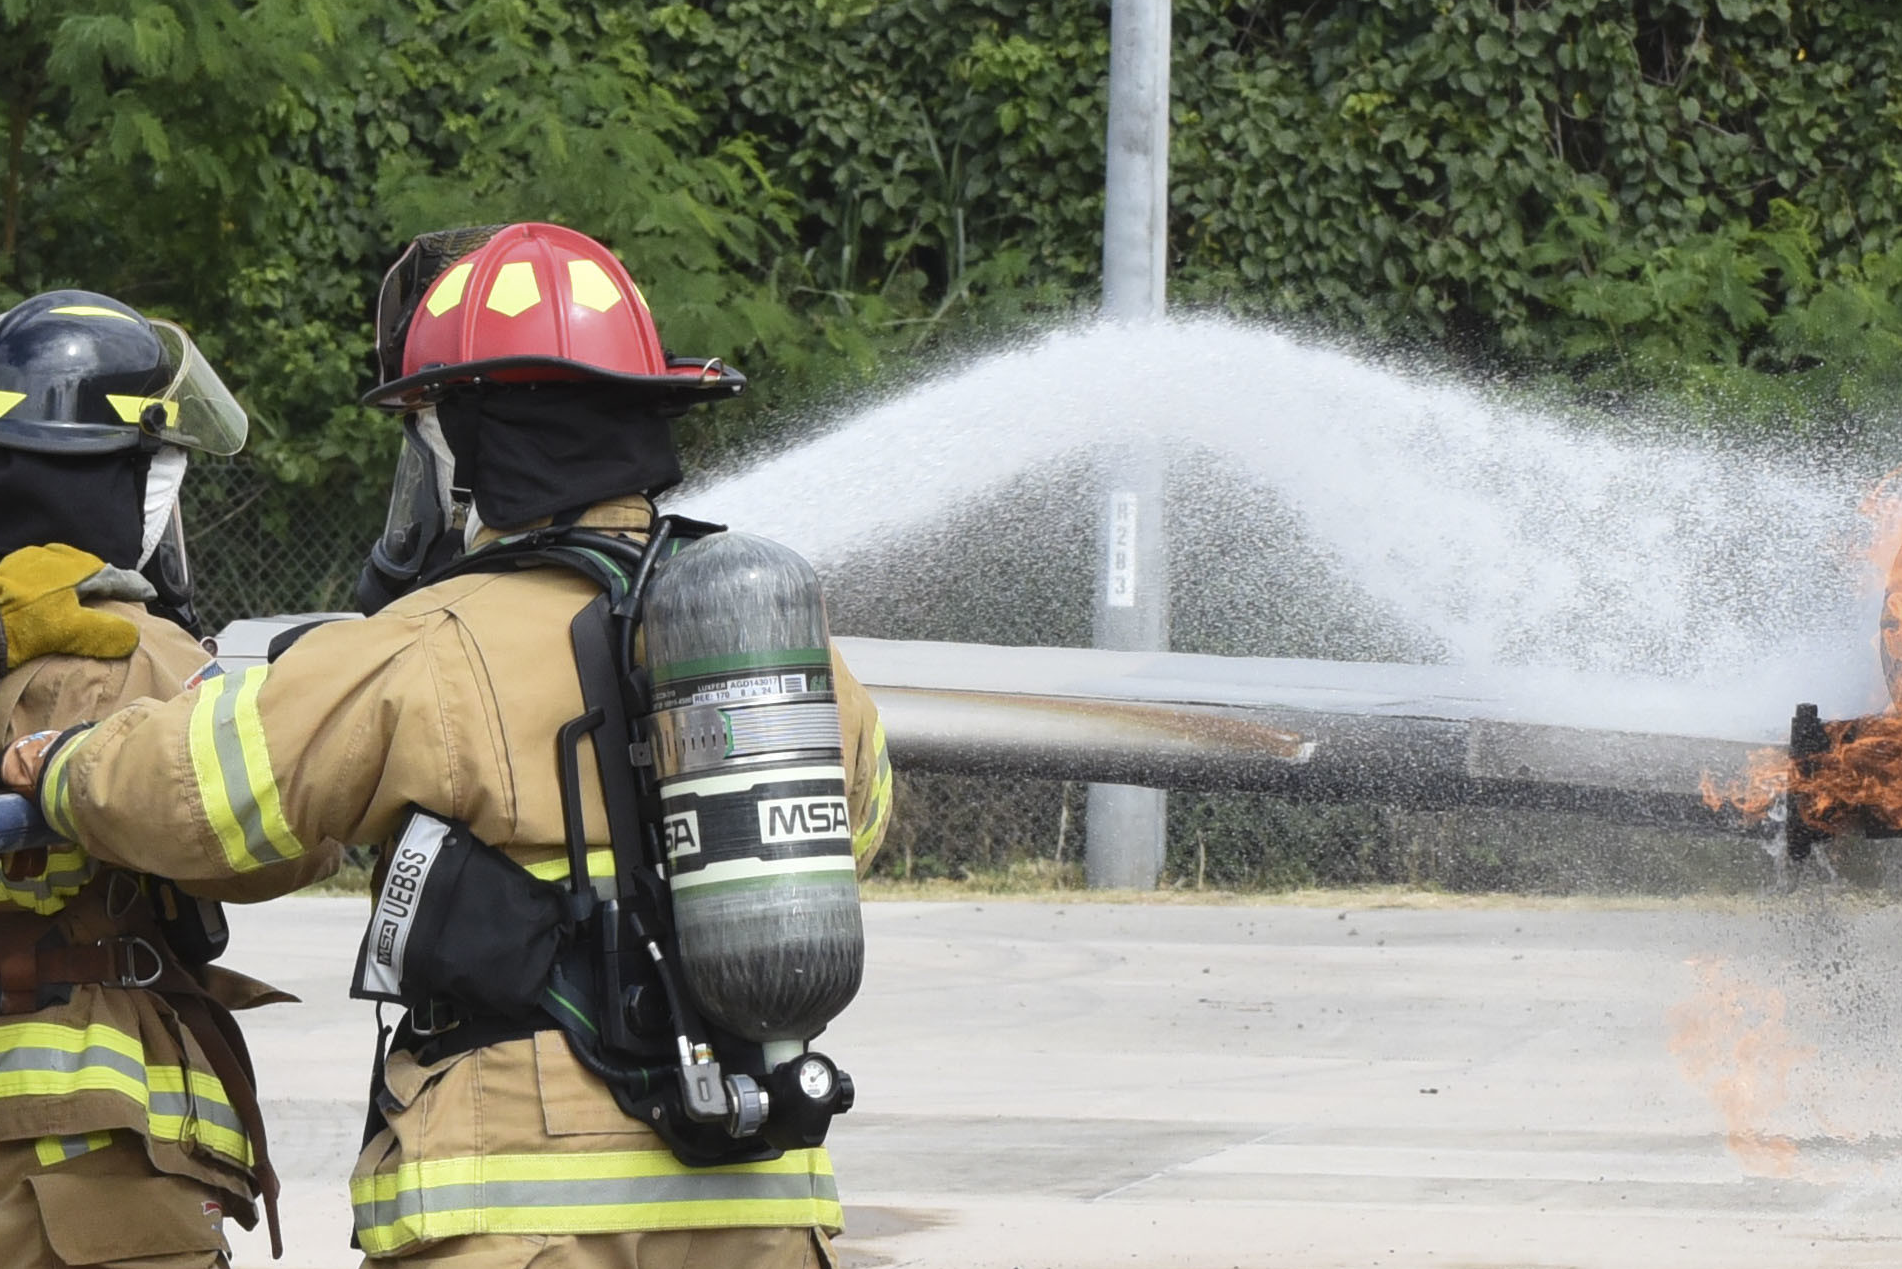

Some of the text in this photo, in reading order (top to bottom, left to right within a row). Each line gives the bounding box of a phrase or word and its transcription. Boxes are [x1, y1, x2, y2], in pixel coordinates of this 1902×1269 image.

[665, 818, 696, 854] SA
[769, 801, 850, 837] MSA
[378, 848, 427, 966] MSA UEBSS
